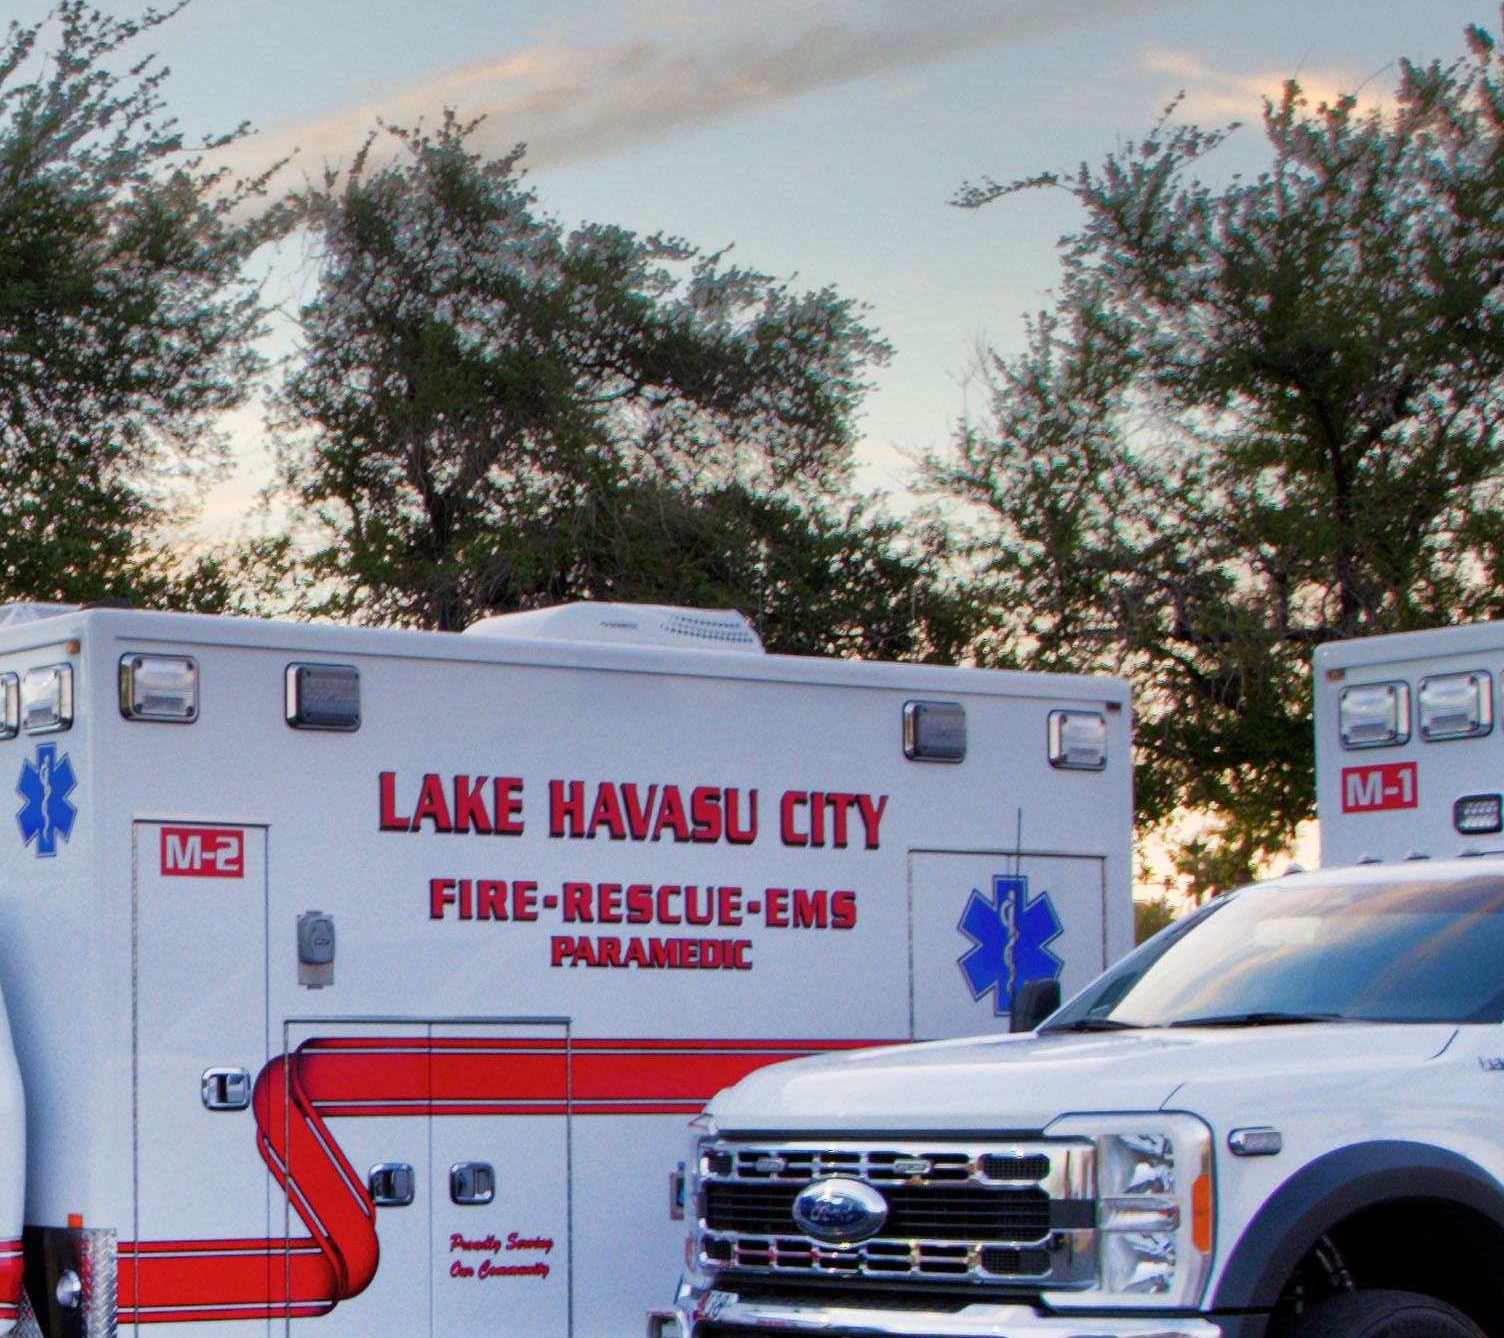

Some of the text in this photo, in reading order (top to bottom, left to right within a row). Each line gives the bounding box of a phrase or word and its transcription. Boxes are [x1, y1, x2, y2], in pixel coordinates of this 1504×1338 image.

[1345, 767, 1413, 808] M-1
[378, 771, 889, 850] LAKE HAVASU CITY
[165, 833, 240, 872] M-2
[549, 935, 753, 970] PARAMEDIC
